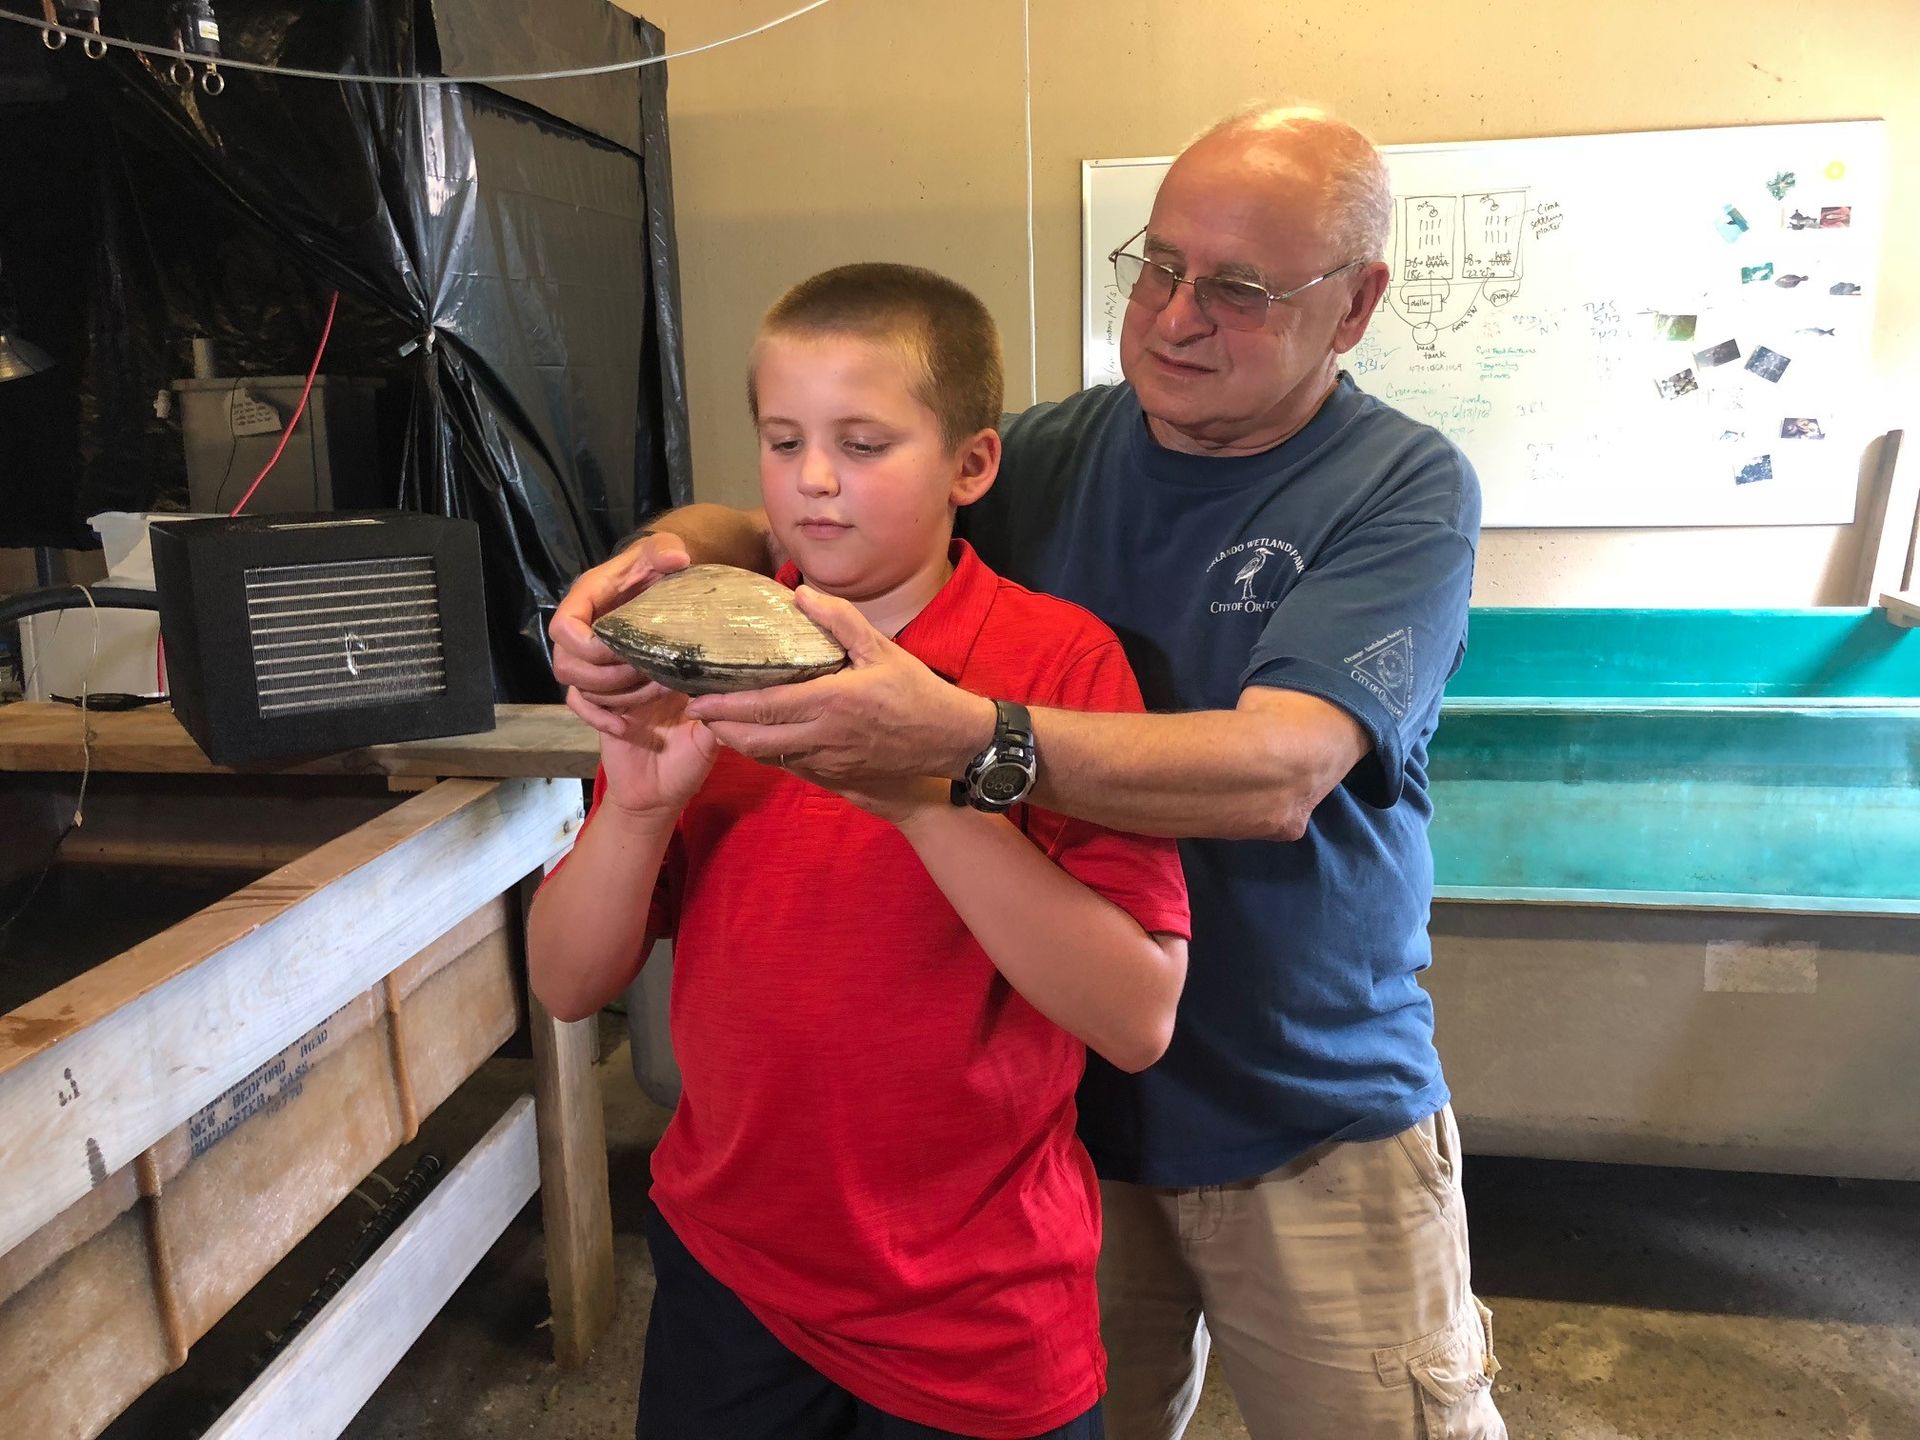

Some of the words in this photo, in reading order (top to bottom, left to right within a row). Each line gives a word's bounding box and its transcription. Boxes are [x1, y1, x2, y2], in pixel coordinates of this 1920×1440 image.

[1246, 538, 1292, 552] WETLAND
[232, 1059, 286, 1109] BEDFORD
[301, 1029, 328, 1058] ROAD
